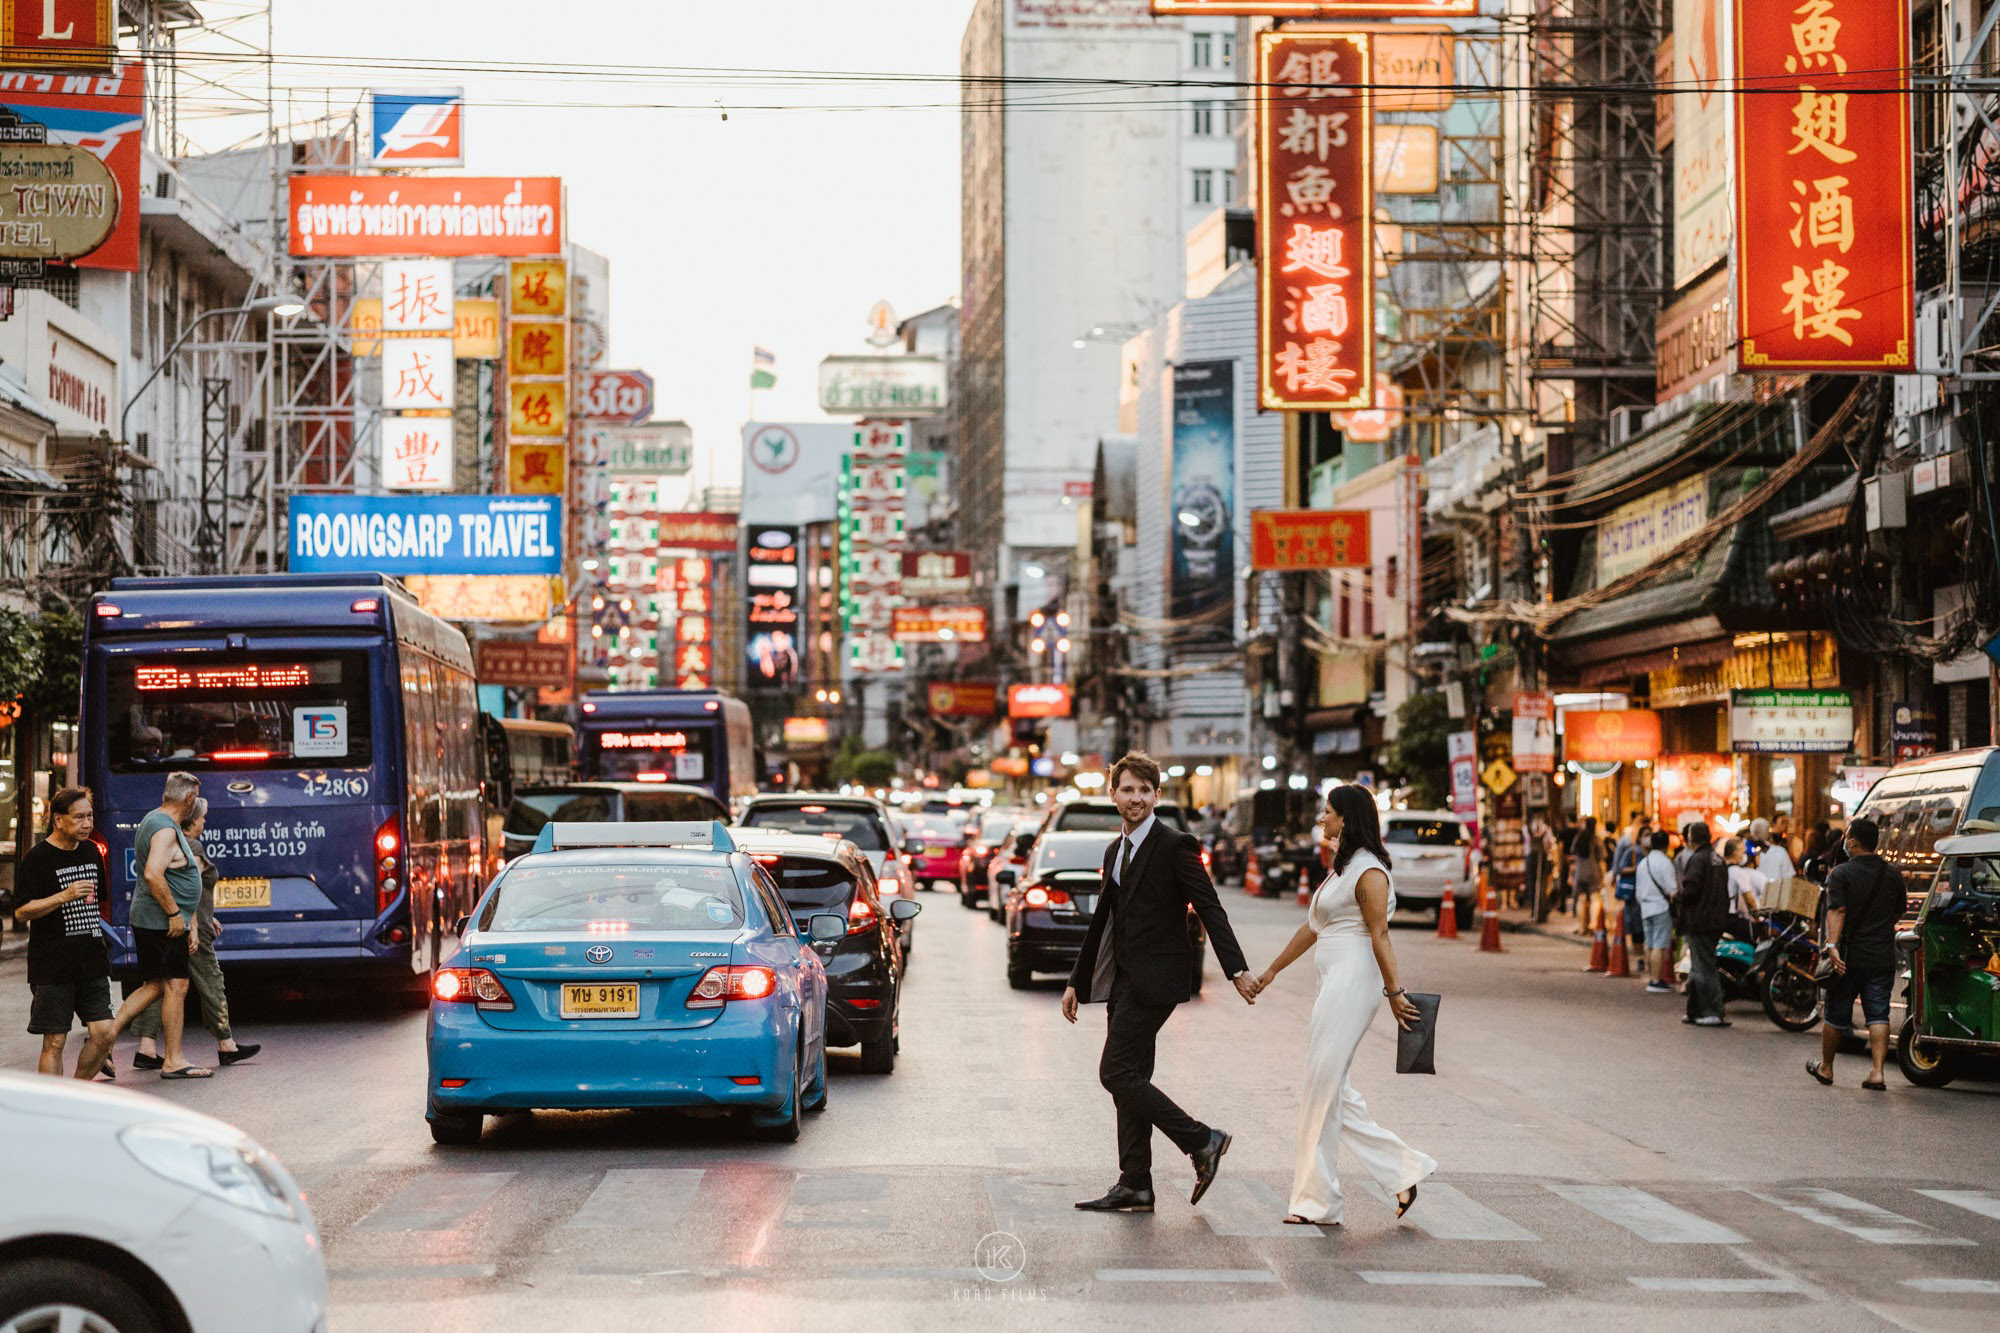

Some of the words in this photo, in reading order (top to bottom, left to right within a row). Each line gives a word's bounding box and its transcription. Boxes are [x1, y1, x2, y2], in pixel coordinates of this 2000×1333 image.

[1782, 0, 1863, 348] 魚翅酒樓
[11, 183, 106, 219] TOWN
[297, 179, 554, 252] รุ่งทรัพย์การท่องเที่ยว
[1276, 49, 1357, 396] 銀都魚翅酒樓
[388, 272, 449, 487] 振成豐
[296, 513, 452, 558] ROONGSARP
[459, 513, 554, 558] TRAVEL
[206, 841, 307, 858] 02-113-1019
[225, 822, 267, 840] สมายล์
[271, 822, 289, 839] บัส
[293, 820, 326, 838] จำกัด
[599, 987, 634, 1003] 9191
